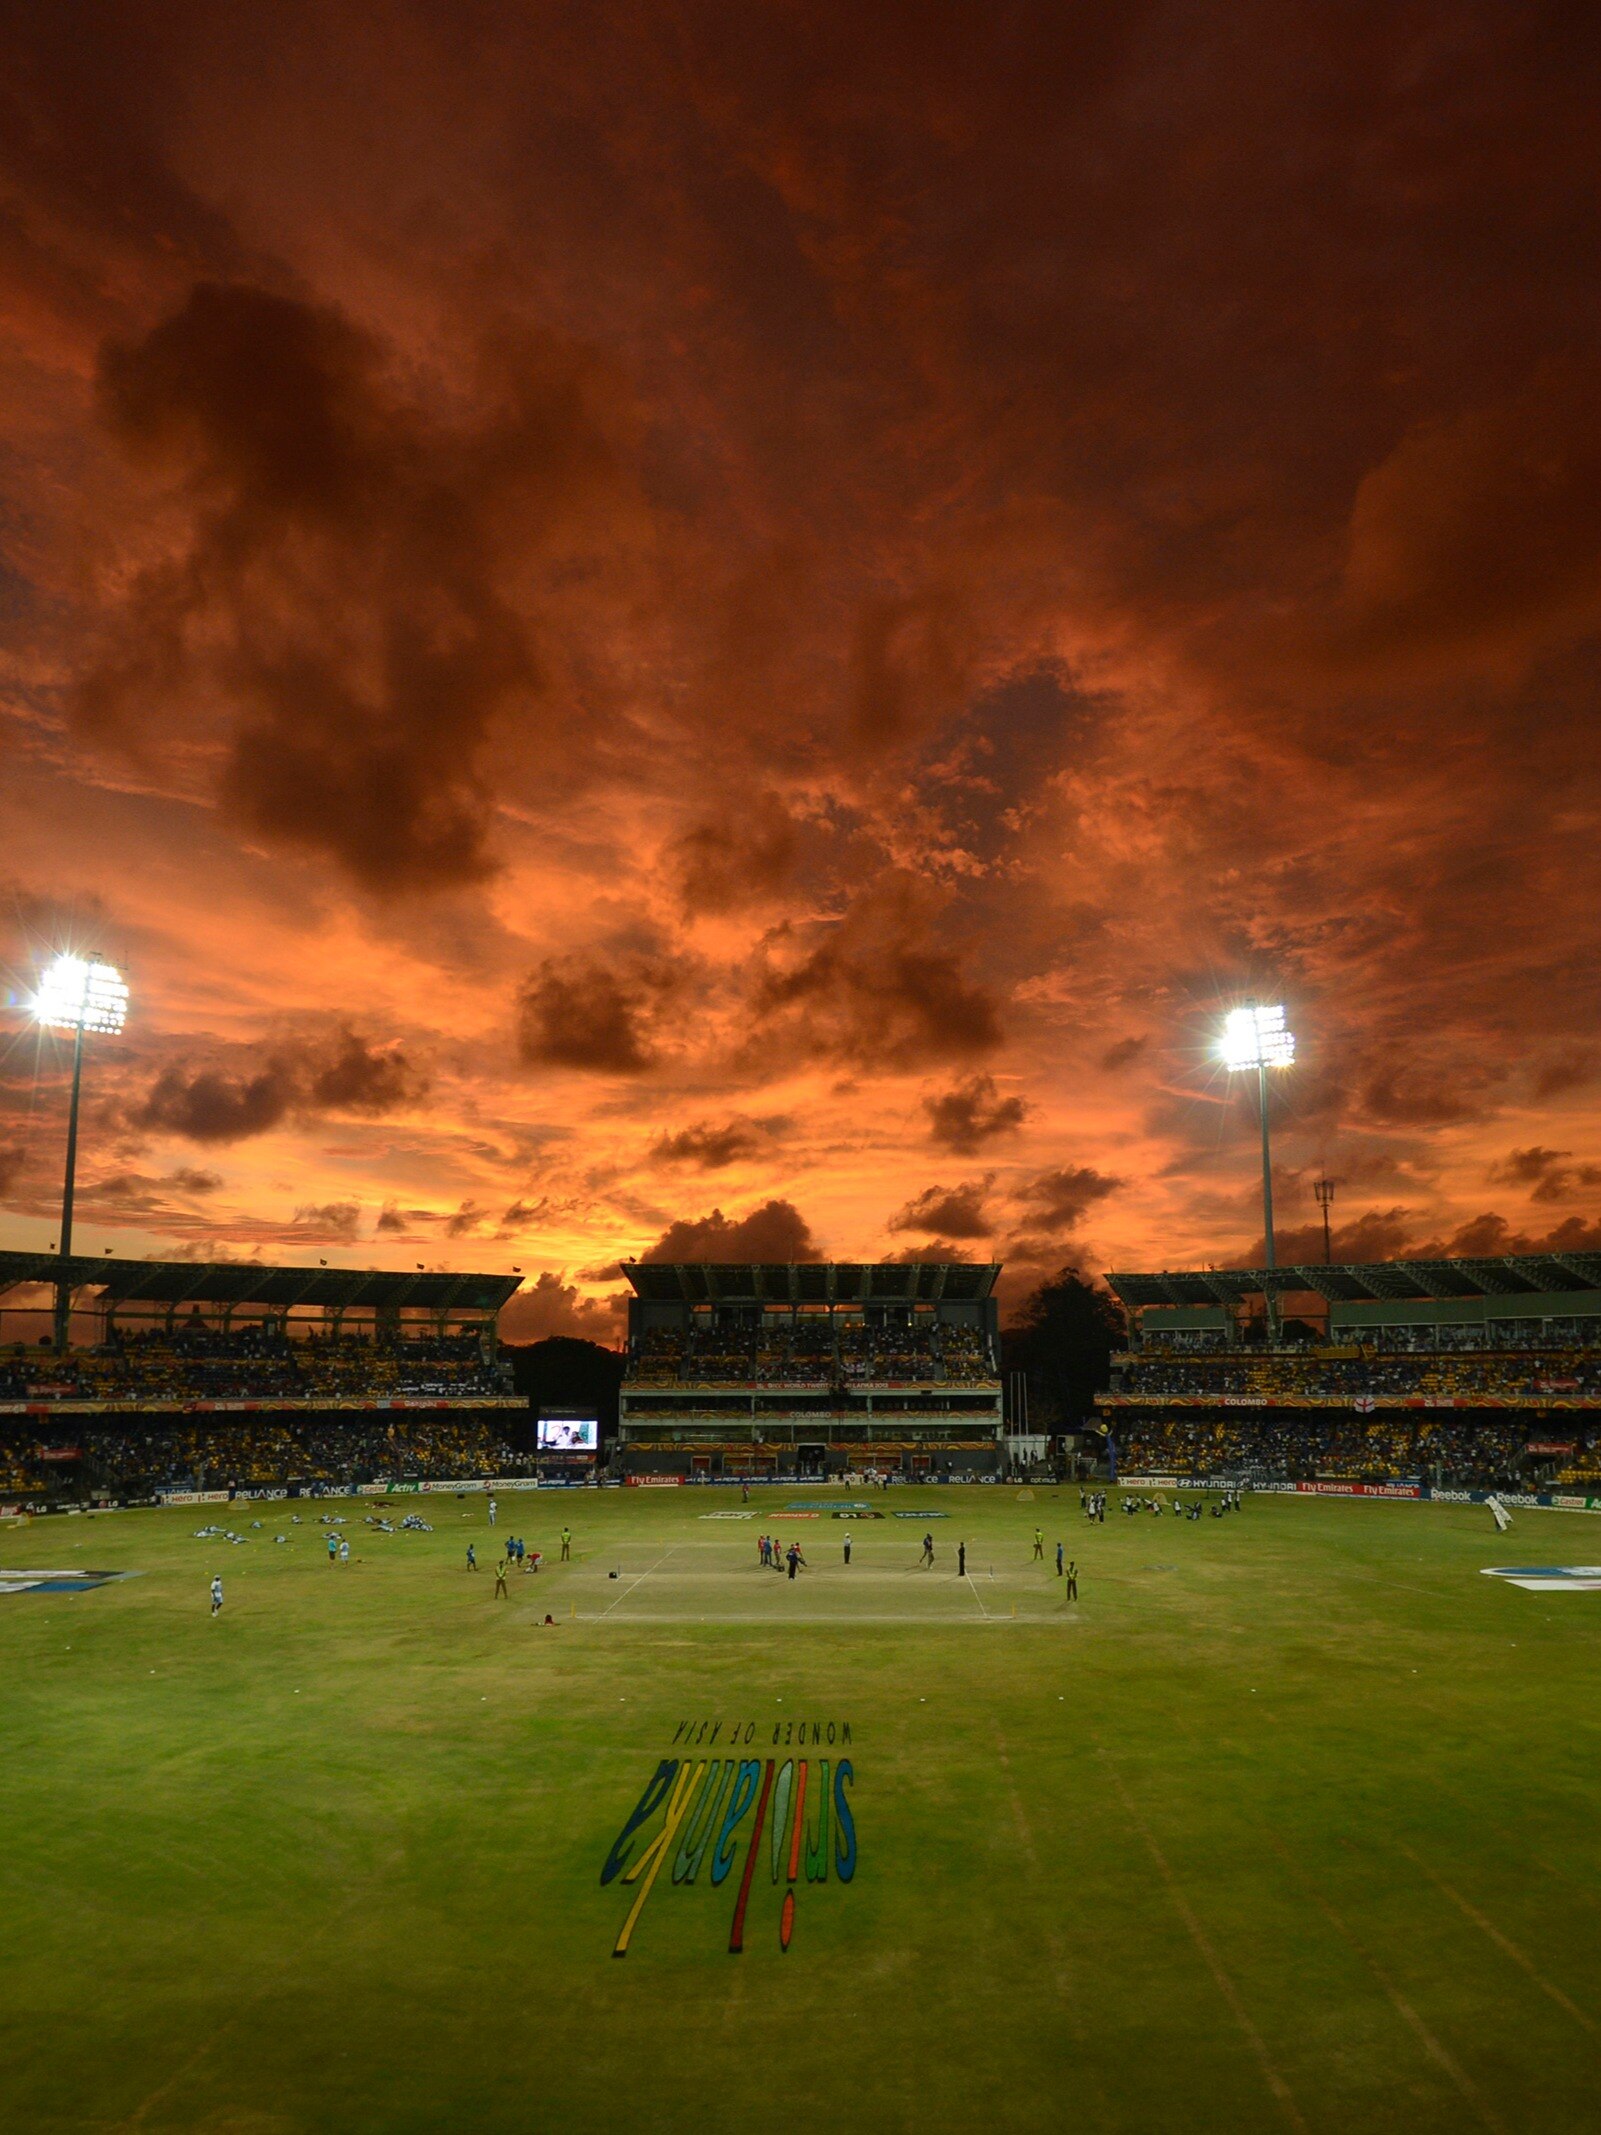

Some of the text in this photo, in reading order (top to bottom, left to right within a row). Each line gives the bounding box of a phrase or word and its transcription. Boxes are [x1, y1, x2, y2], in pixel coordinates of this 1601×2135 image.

[1224, 1398, 1268, 1406] COLOMBO
[492, 1480, 536, 1489] MoneyGram
[631, 1475, 679, 1484] Fly Emirates
[391, 1484, 416, 1493] Activ
[432, 1482, 477, 1492] MoneyGram
[1302, 1483, 1353, 1493] Fly Emirates
[1363, 1485, 1415, 1496] Fly Emirates
[1430, 1488, 1471, 1501] Reebok
[1496, 1492, 1538, 1505] Reebok
[36, 1505, 47, 1513] LG
[672, 1721, 852, 1745] WONDER OF ASIA
